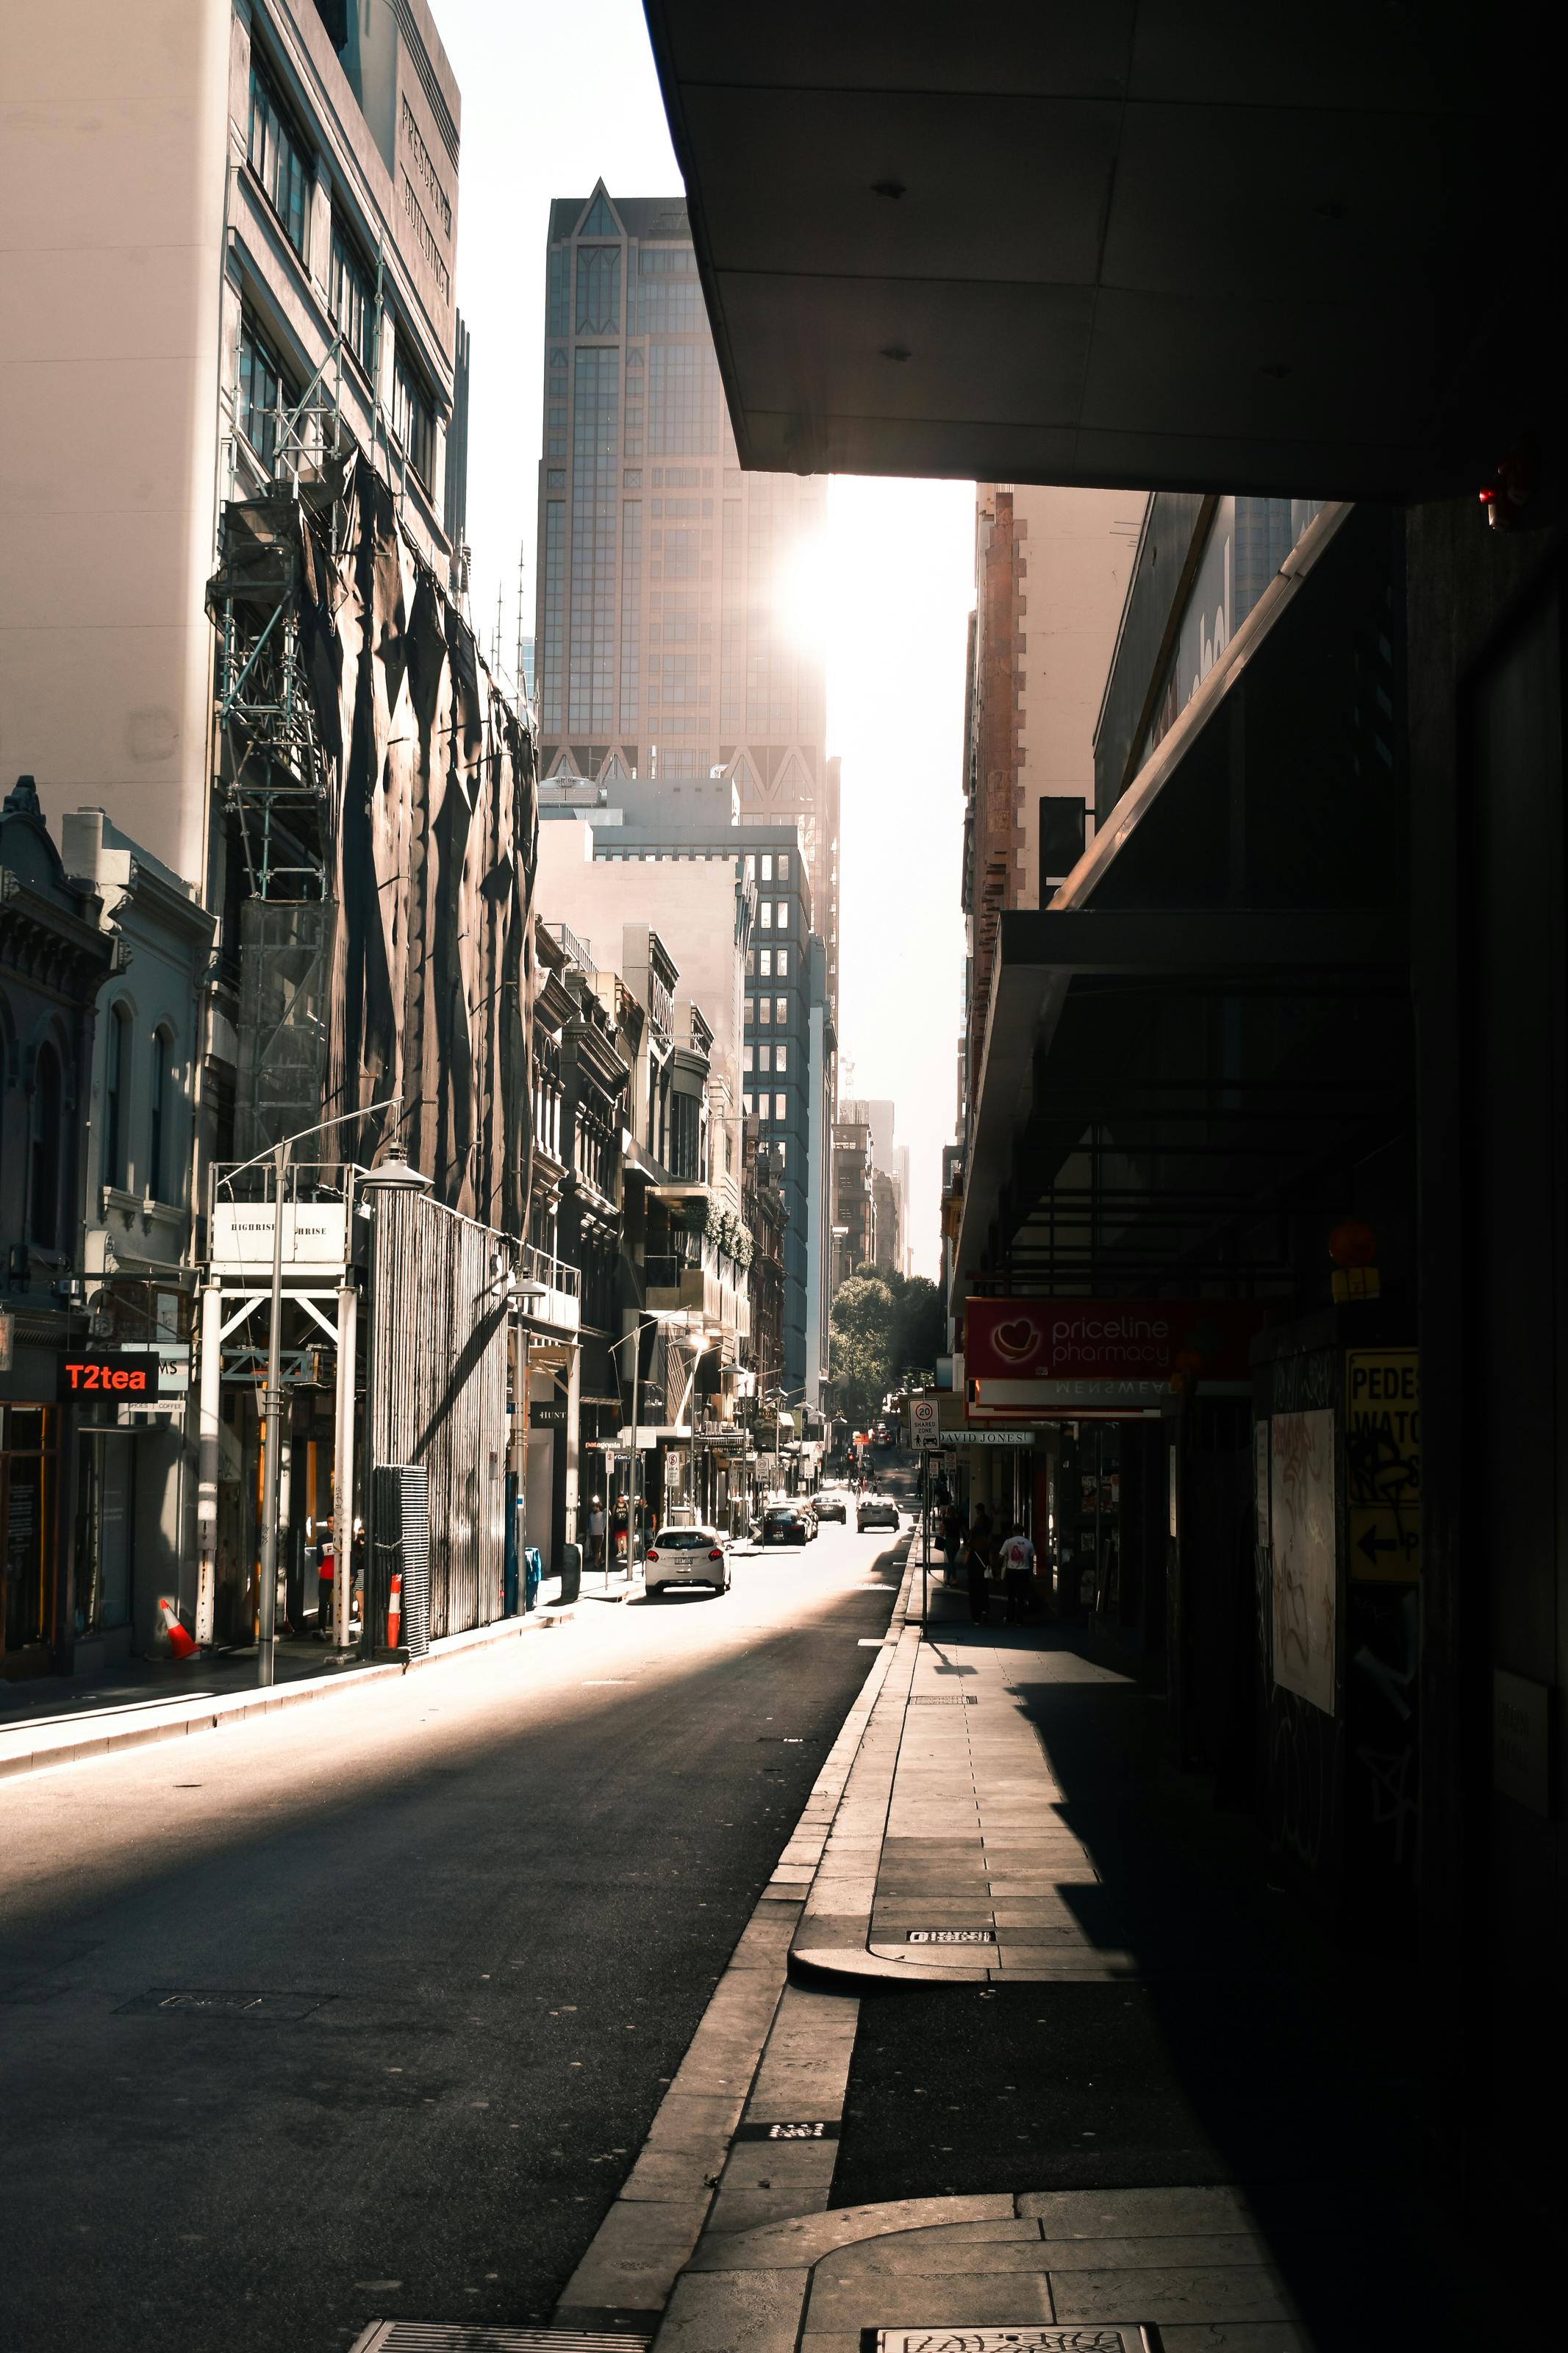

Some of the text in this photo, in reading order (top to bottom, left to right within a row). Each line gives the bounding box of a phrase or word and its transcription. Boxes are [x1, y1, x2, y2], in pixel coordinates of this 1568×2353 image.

[402, 97, 450, 237] PRESGRAVE
[405, 176, 444, 293] BUILDING
[1053, 1316, 1169, 1344] priceline
[1053, 1341, 1170, 1366] pharmacy
[65, 1365, 146, 1390] T2tea
[1353, 1367, 1419, 1399] PEDE
[919, 1407, 930, 1416] 20
[980, 1433, 1023, 1443] JONES
